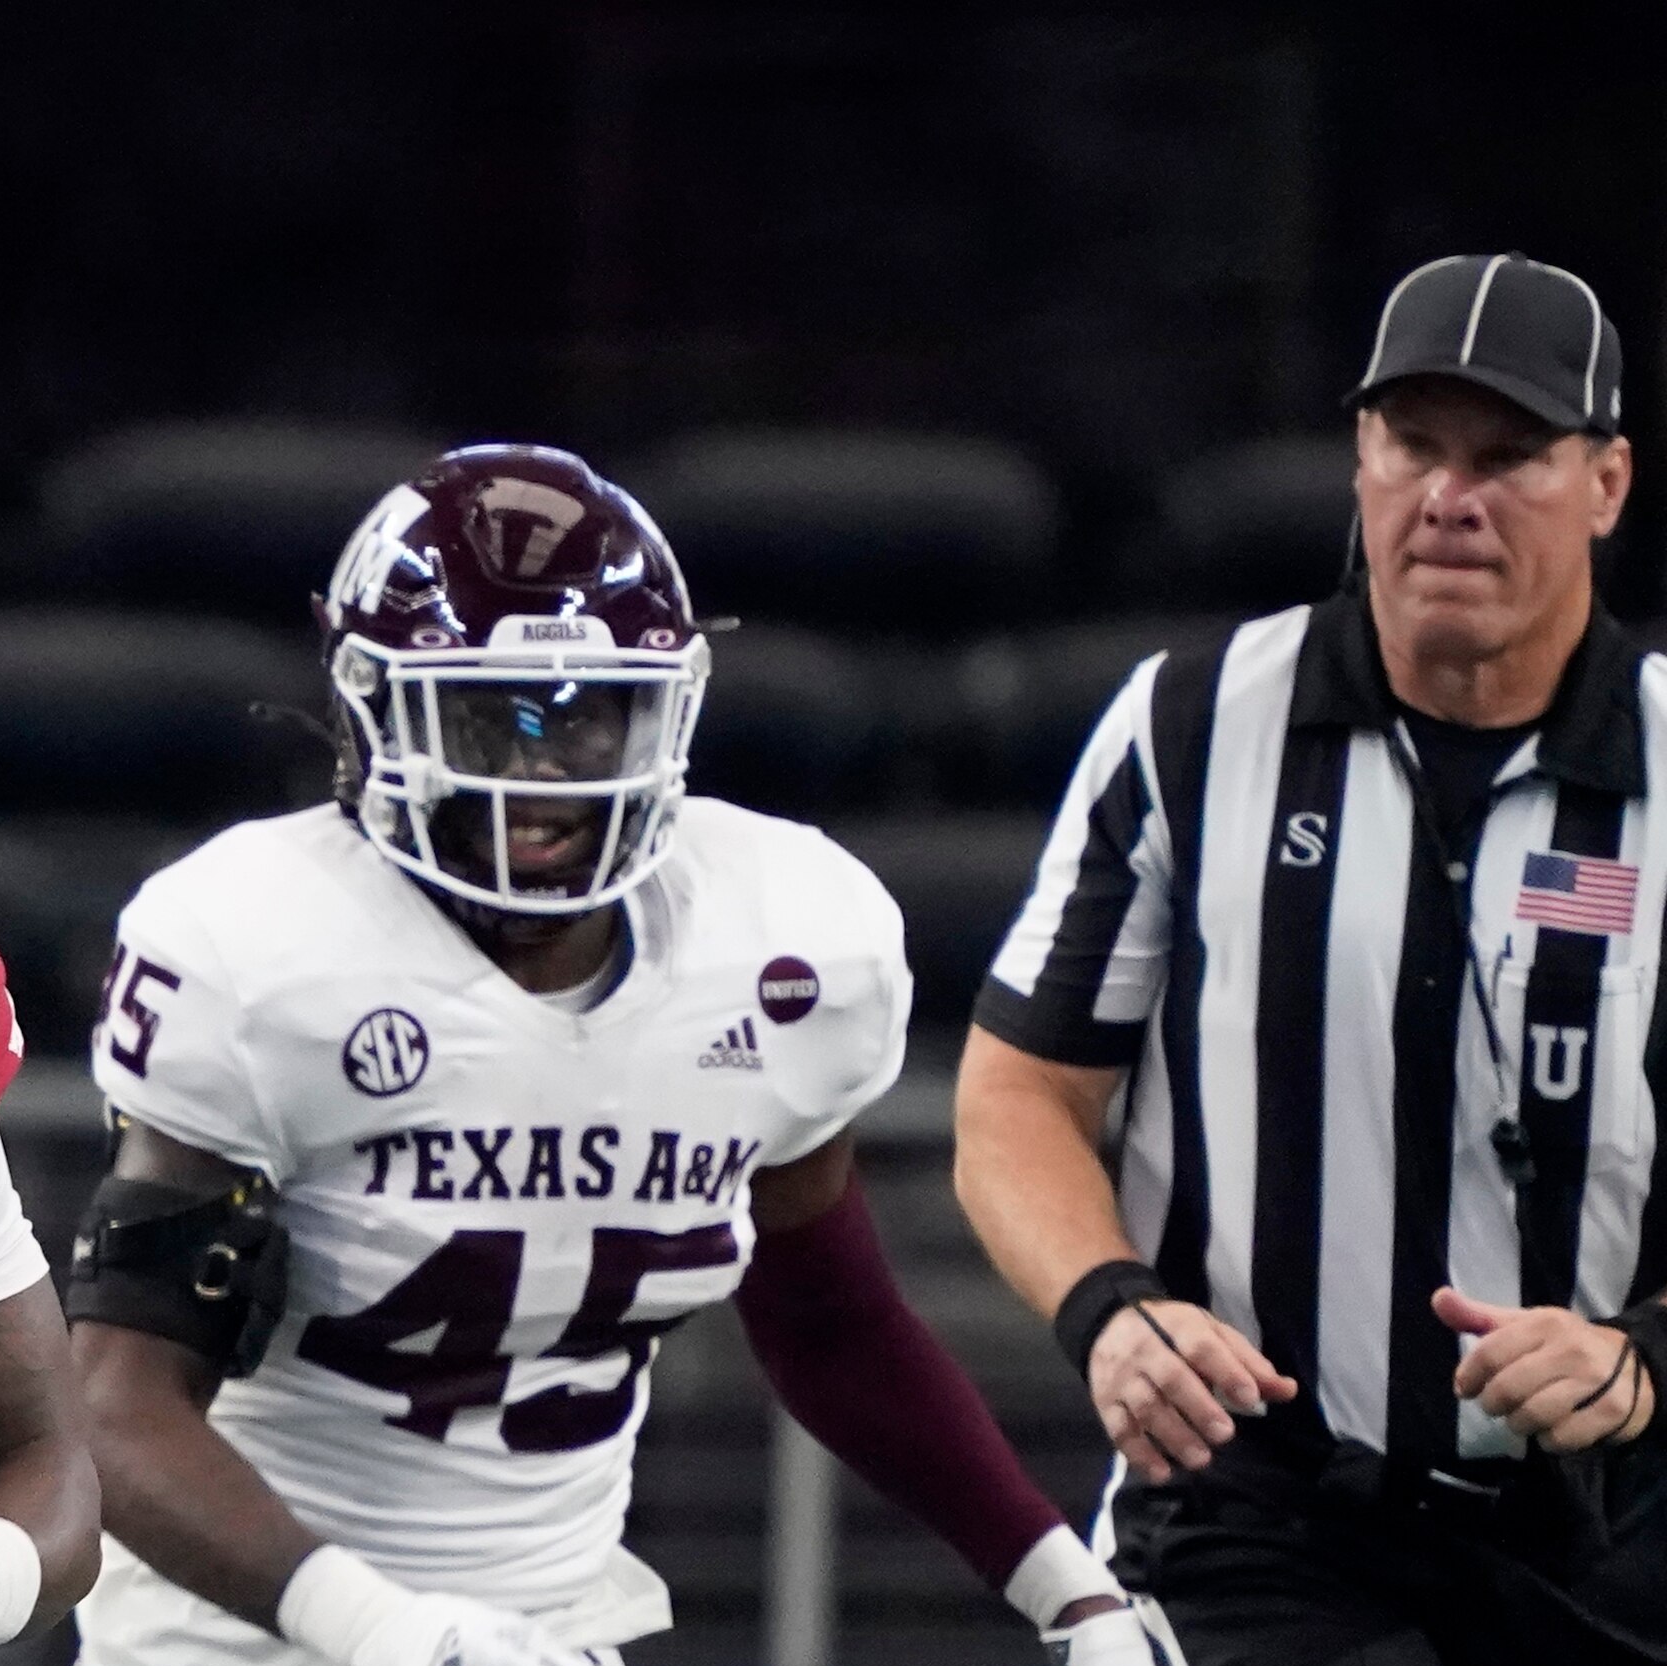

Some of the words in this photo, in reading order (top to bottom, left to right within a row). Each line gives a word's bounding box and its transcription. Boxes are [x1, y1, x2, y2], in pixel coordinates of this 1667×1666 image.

[1279, 811, 1327, 868] S
[349, 1018, 425, 1091] SEC
[1529, 1023, 1588, 1100] U
[354, 1126, 620, 1202] TEXAS
[634, 1131, 763, 1208] A&M
[297, 1222, 740, 1454] 45
